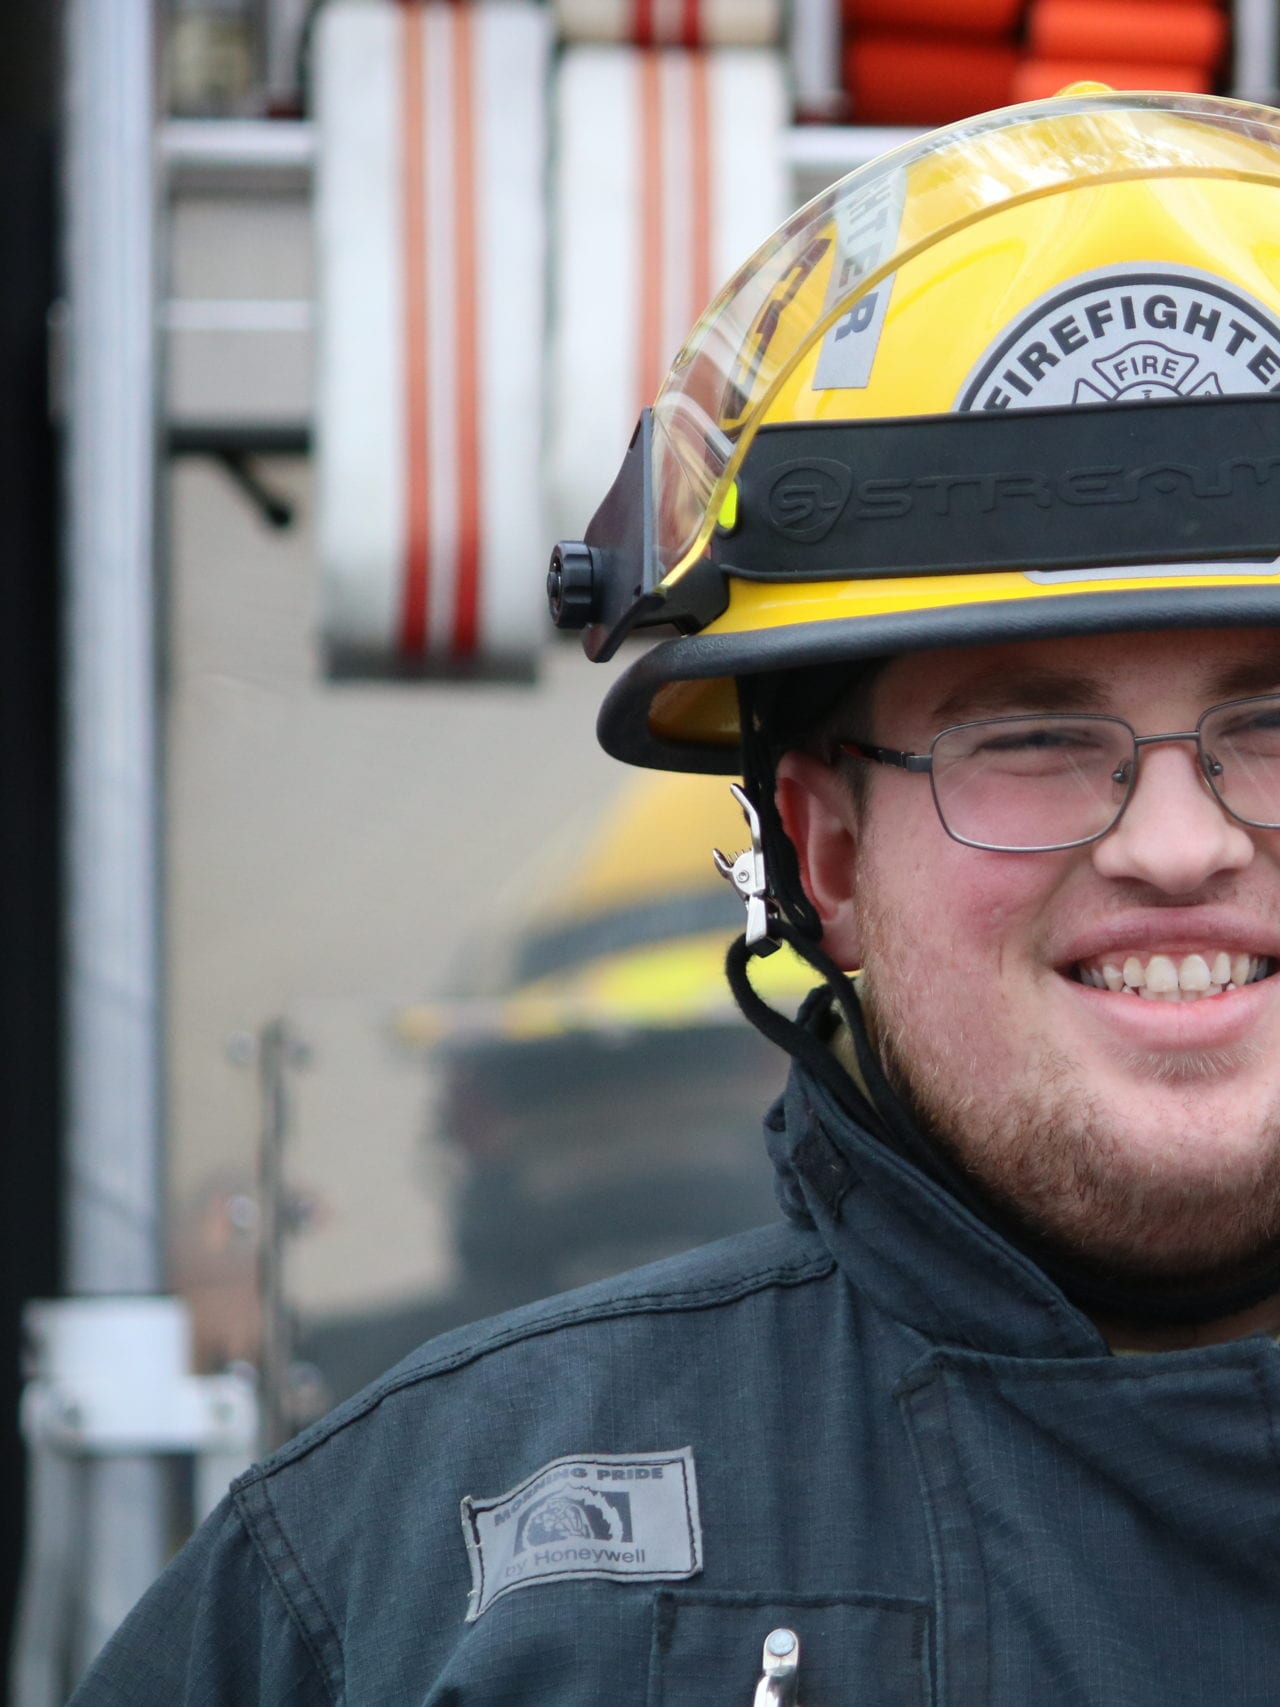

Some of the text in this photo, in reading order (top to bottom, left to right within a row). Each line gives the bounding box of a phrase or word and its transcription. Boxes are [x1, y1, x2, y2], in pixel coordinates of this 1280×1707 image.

[1112, 354, 1180, 382] FIRE
[494, 1467, 663, 1527] MORNING PRIDE
[505, 1548, 646, 1577] by Honeywell
